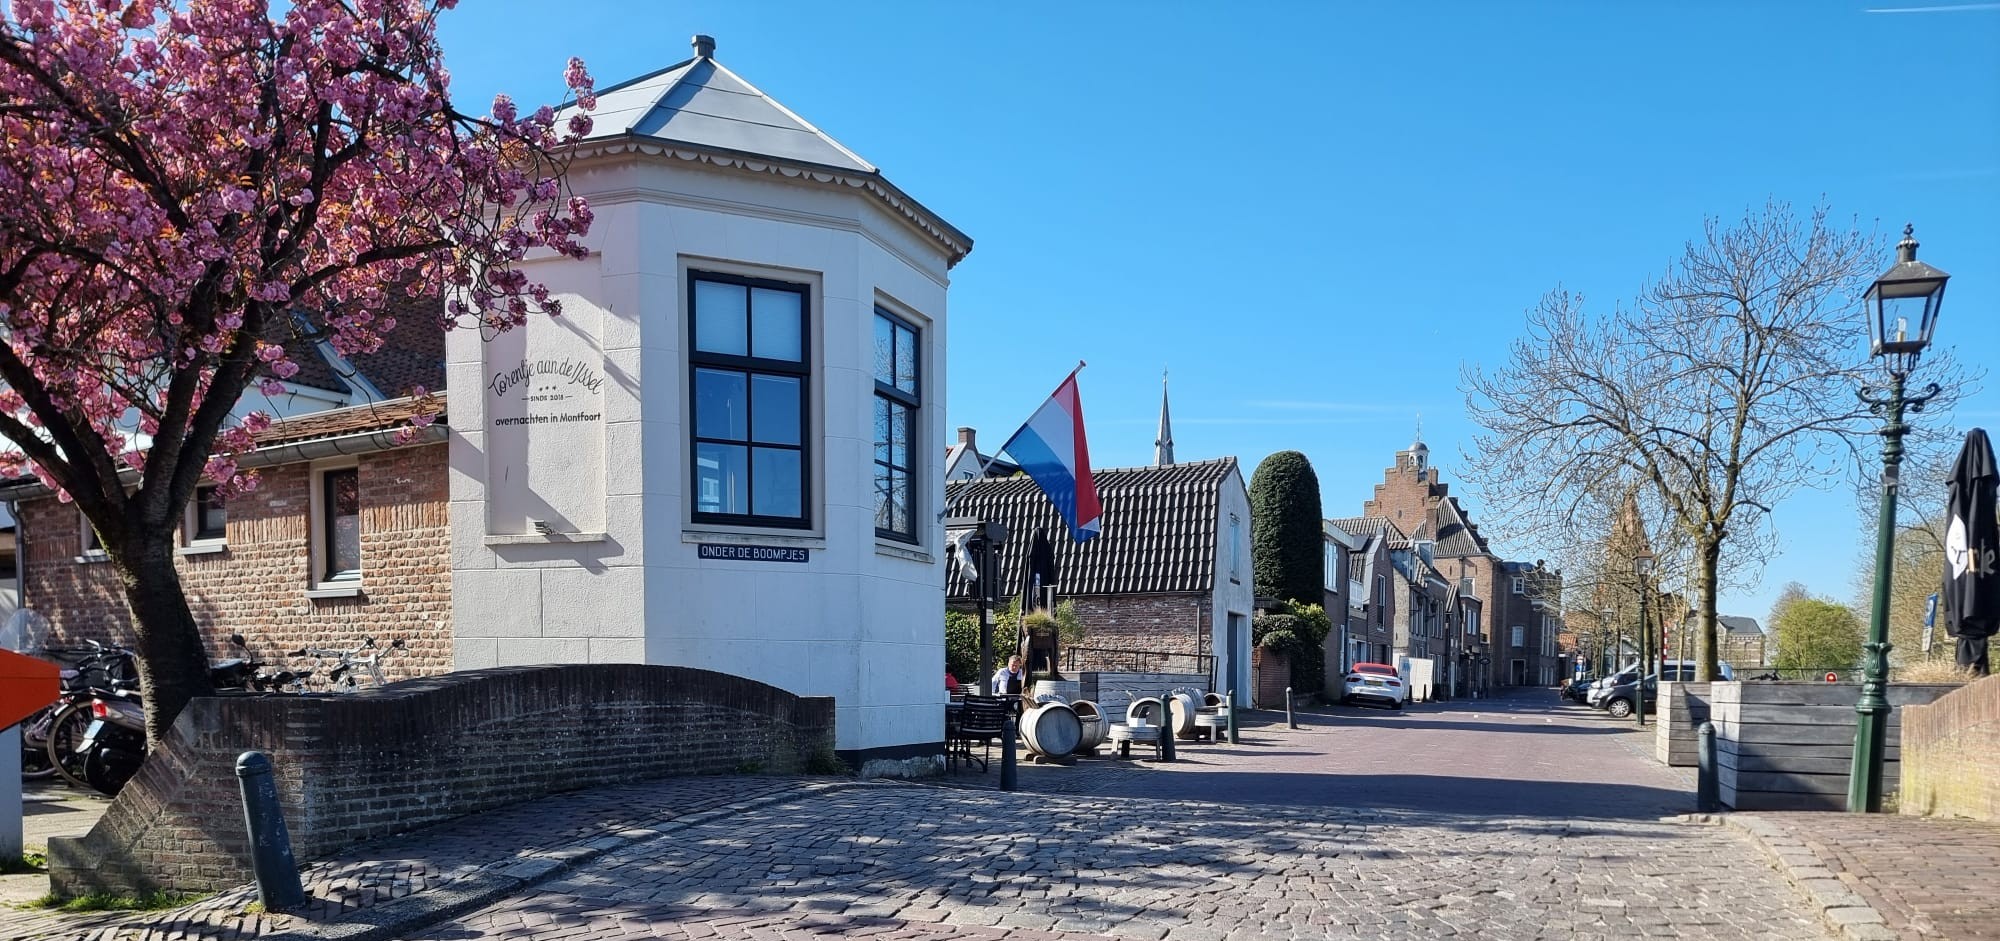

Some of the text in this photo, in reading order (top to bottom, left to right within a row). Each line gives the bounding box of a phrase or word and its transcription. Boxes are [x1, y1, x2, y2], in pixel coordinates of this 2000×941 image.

[488, 359, 534, 396] Torentje
[537, 360, 558, 374] aan
[560, 356, 571, 376] de
[495, 411, 601, 426] overnachten in Montfoort
[701, 545, 805, 560] ONDER DE BOOMPJES
